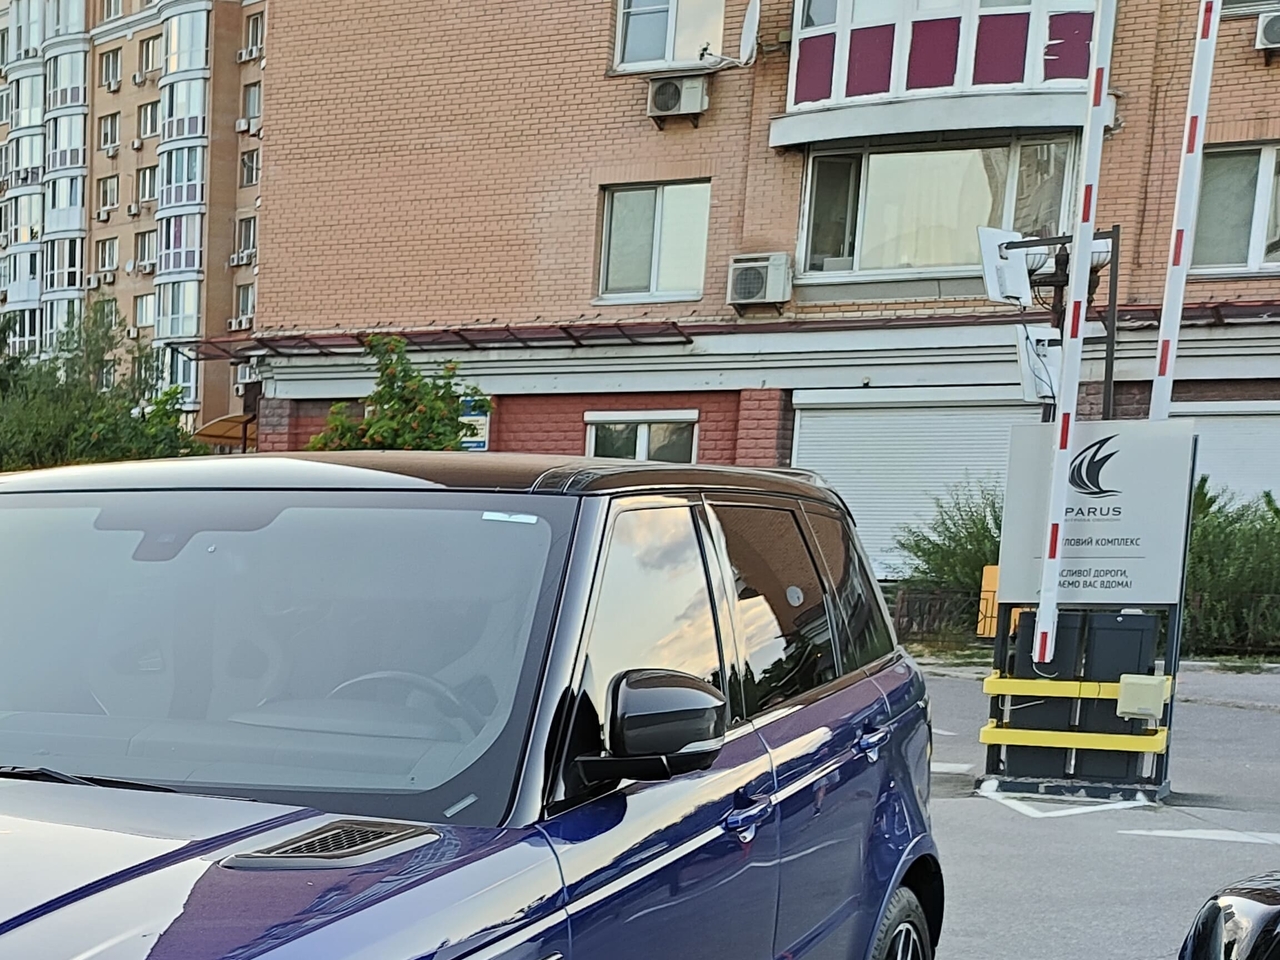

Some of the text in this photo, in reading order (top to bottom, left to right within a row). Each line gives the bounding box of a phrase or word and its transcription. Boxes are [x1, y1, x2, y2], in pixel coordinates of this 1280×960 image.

[1064, 507, 1122, 517] PARUS
[1062, 536, 1141, 547] ЛОВИЙ КОМПЛЕКС
[1059, 568, 1128, 578] СЛИВОЇ ДОРОГИ,
[1082, 580, 1098, 588] ВАС
[1100, 580, 1132, 589] ВДОМА!
